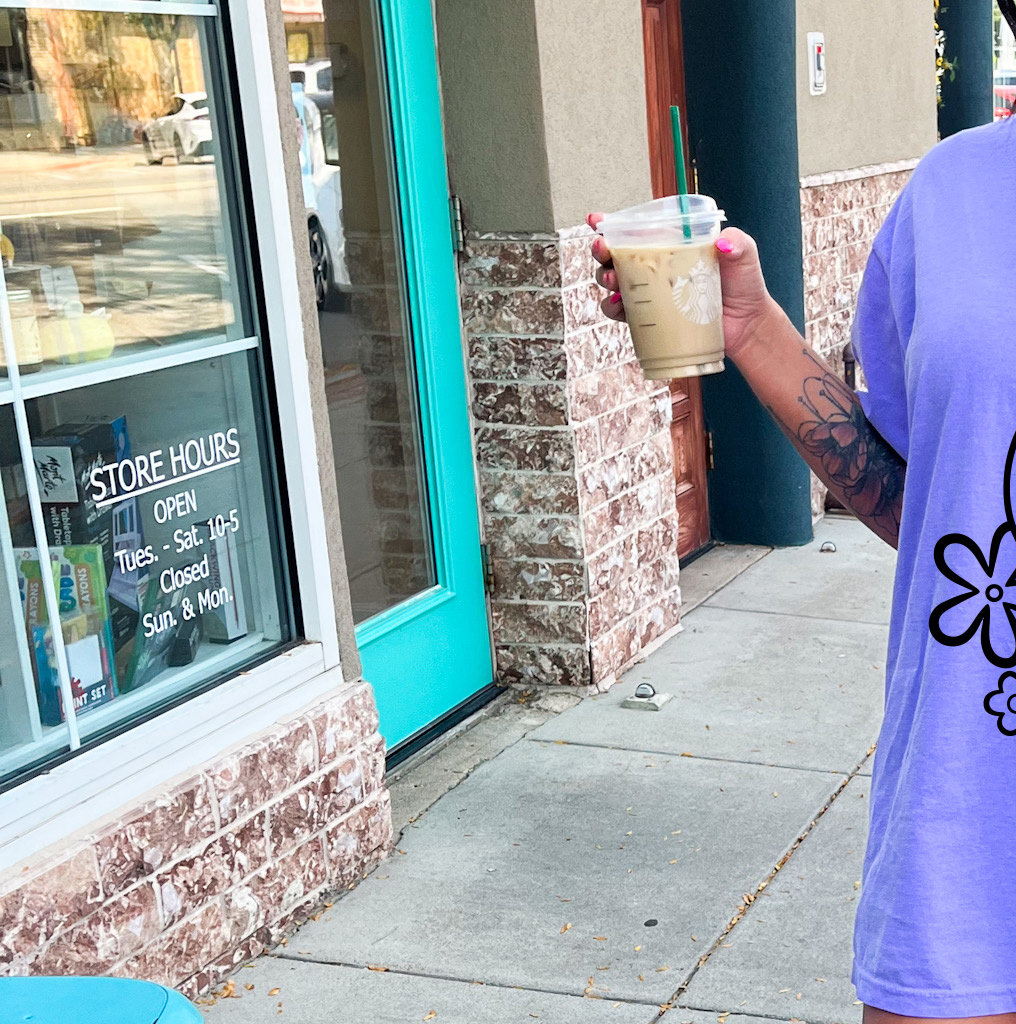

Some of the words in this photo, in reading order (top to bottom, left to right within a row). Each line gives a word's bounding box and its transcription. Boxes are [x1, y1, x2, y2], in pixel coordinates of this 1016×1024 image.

[90, 450, 165, 501] STORE
[169, 428, 240, 476] HOURS
[154, 489, 197, 524] OPEN
[114, 545, 159, 574] Tues.
[173, 526, 203, 553] Sat.
[207, 509, 239, 540] 10-5
[78, 568, 89, 604] AYONS
[160, 554, 210, 594] Closed
[143, 610, 177, 638] Sun.
[181, 597, 196, 620] &
[198, 586, 233, 614] Mon.
[91, 685, 107, 703] SET
